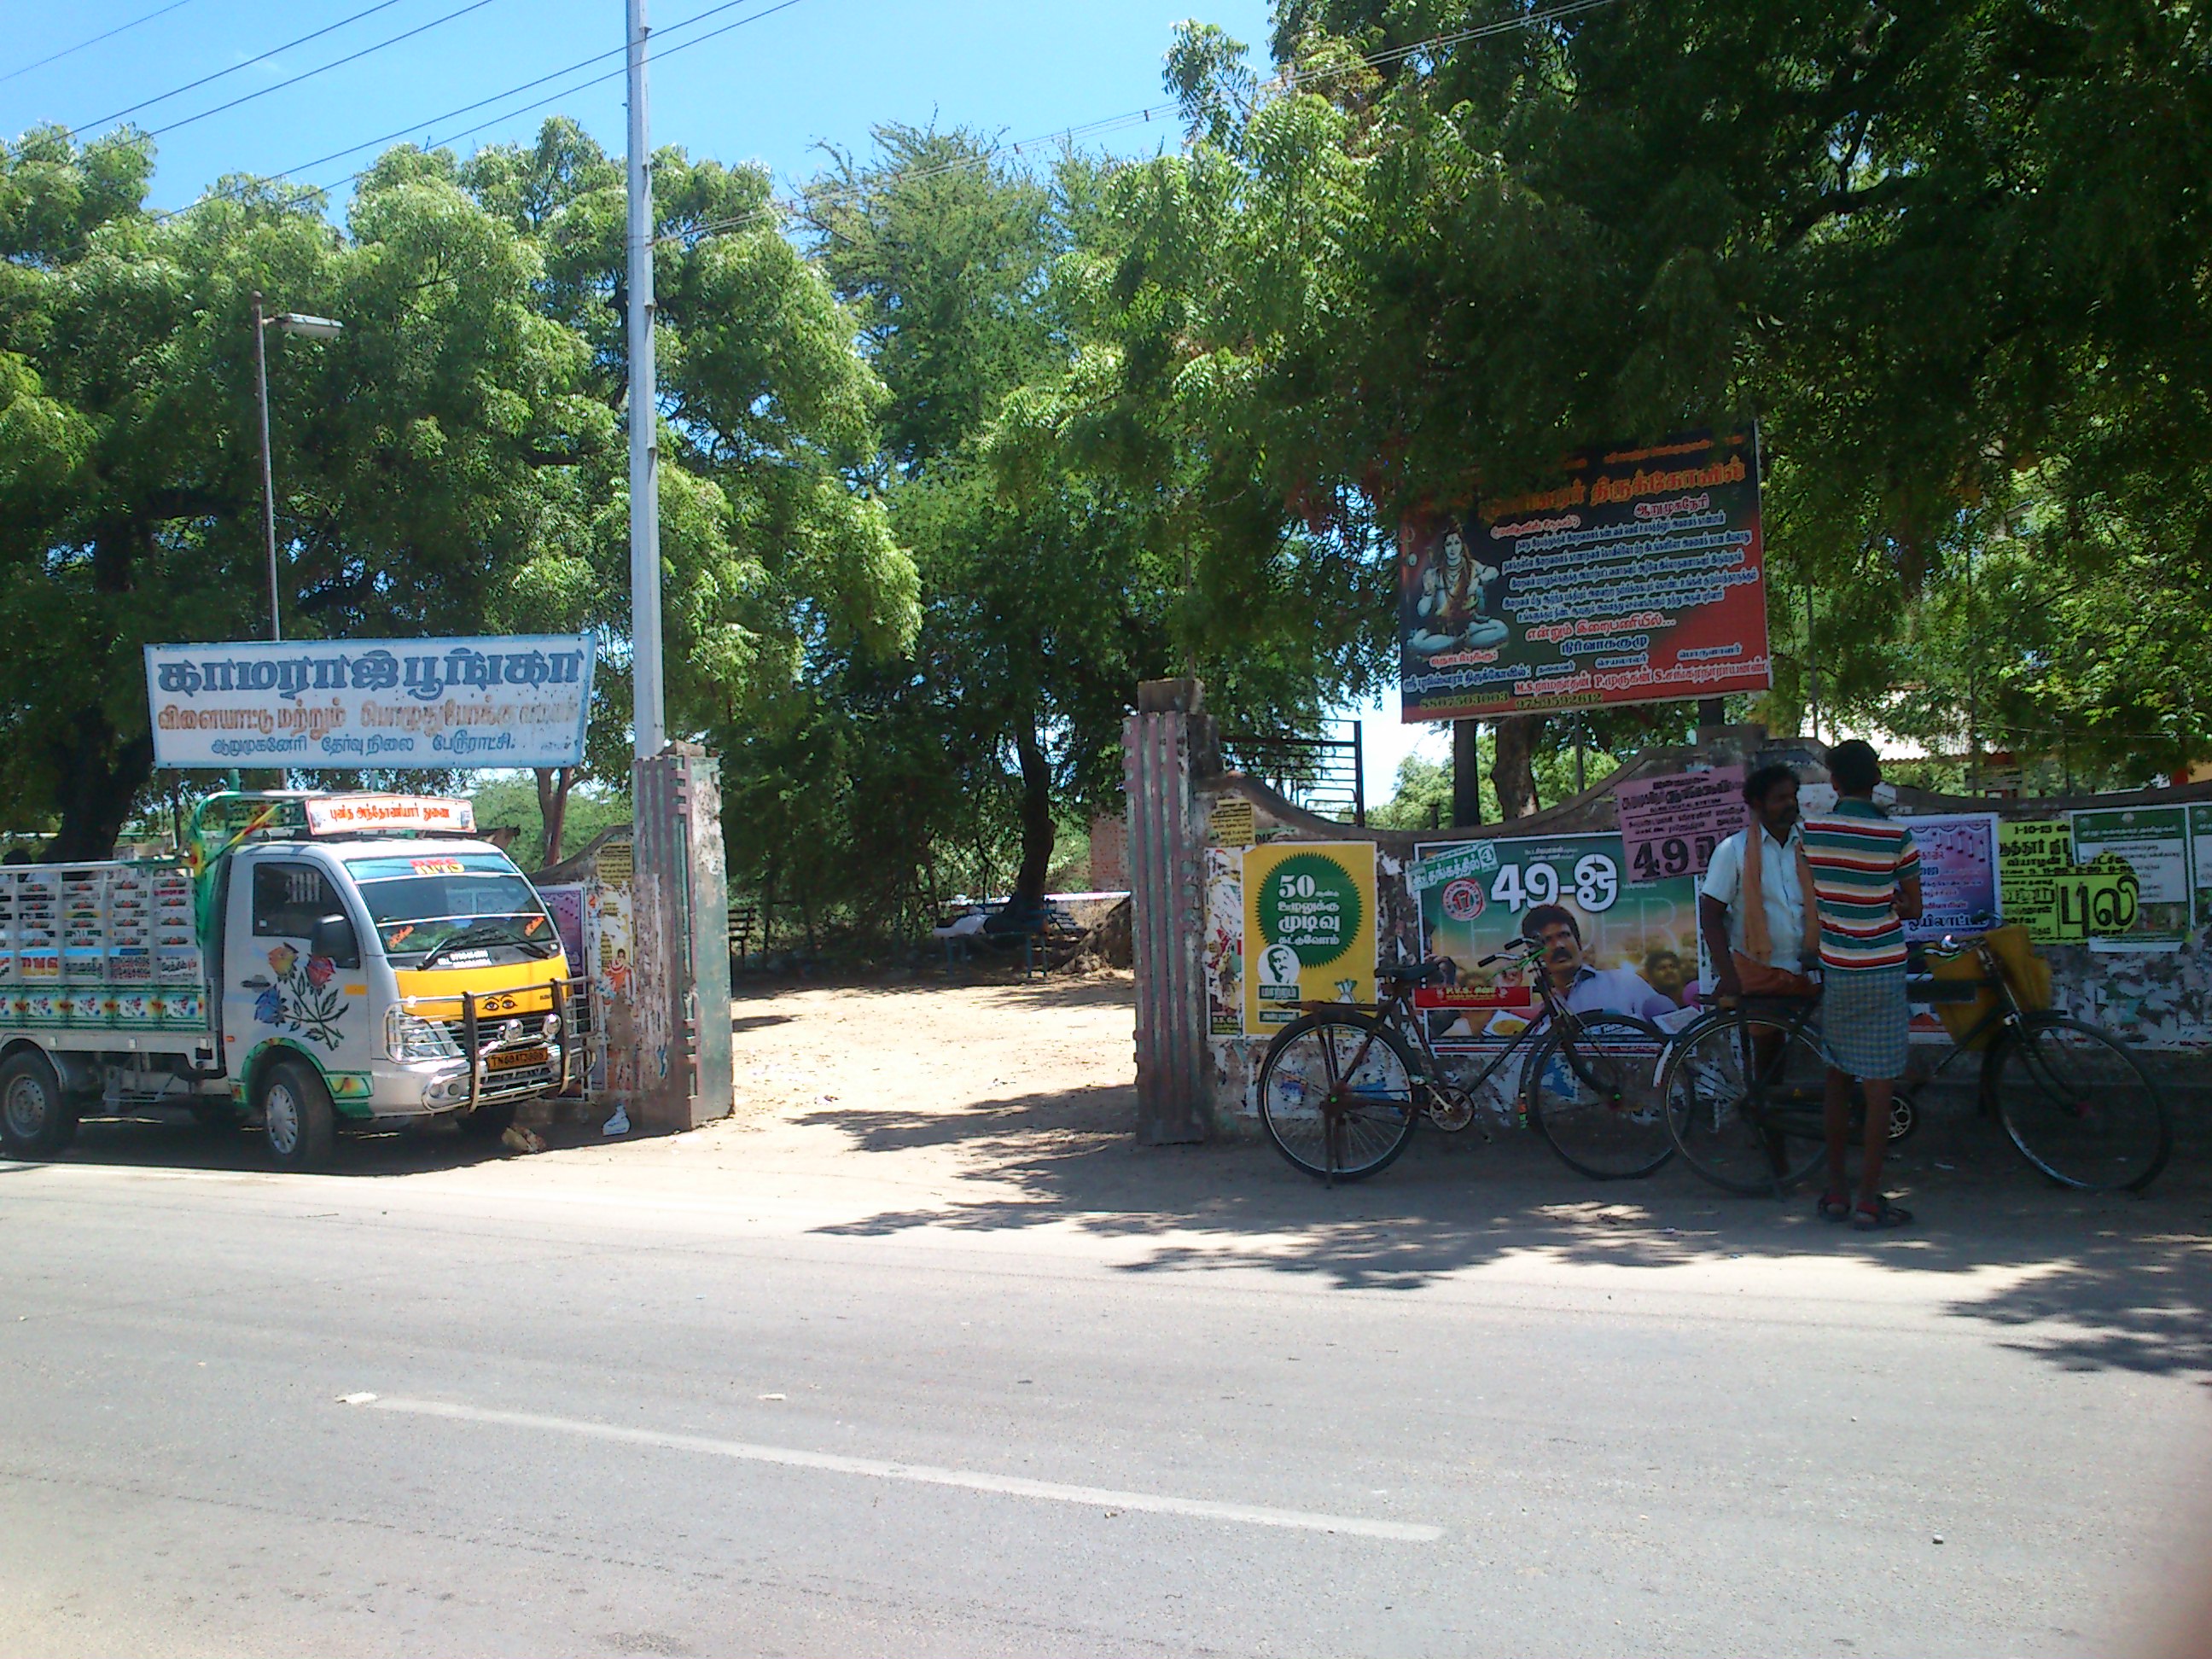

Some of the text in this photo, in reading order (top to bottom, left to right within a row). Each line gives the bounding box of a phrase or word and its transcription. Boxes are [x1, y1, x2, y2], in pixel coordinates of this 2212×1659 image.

[159, 705, 273, 734] விளையாட்டு
[277, 697, 346, 740] மற்றும்
[1278, 874, 1315, 899] 50
[2060, 875, 2140, 936] புலி
[1278, 916, 1340, 934] முடிவு
